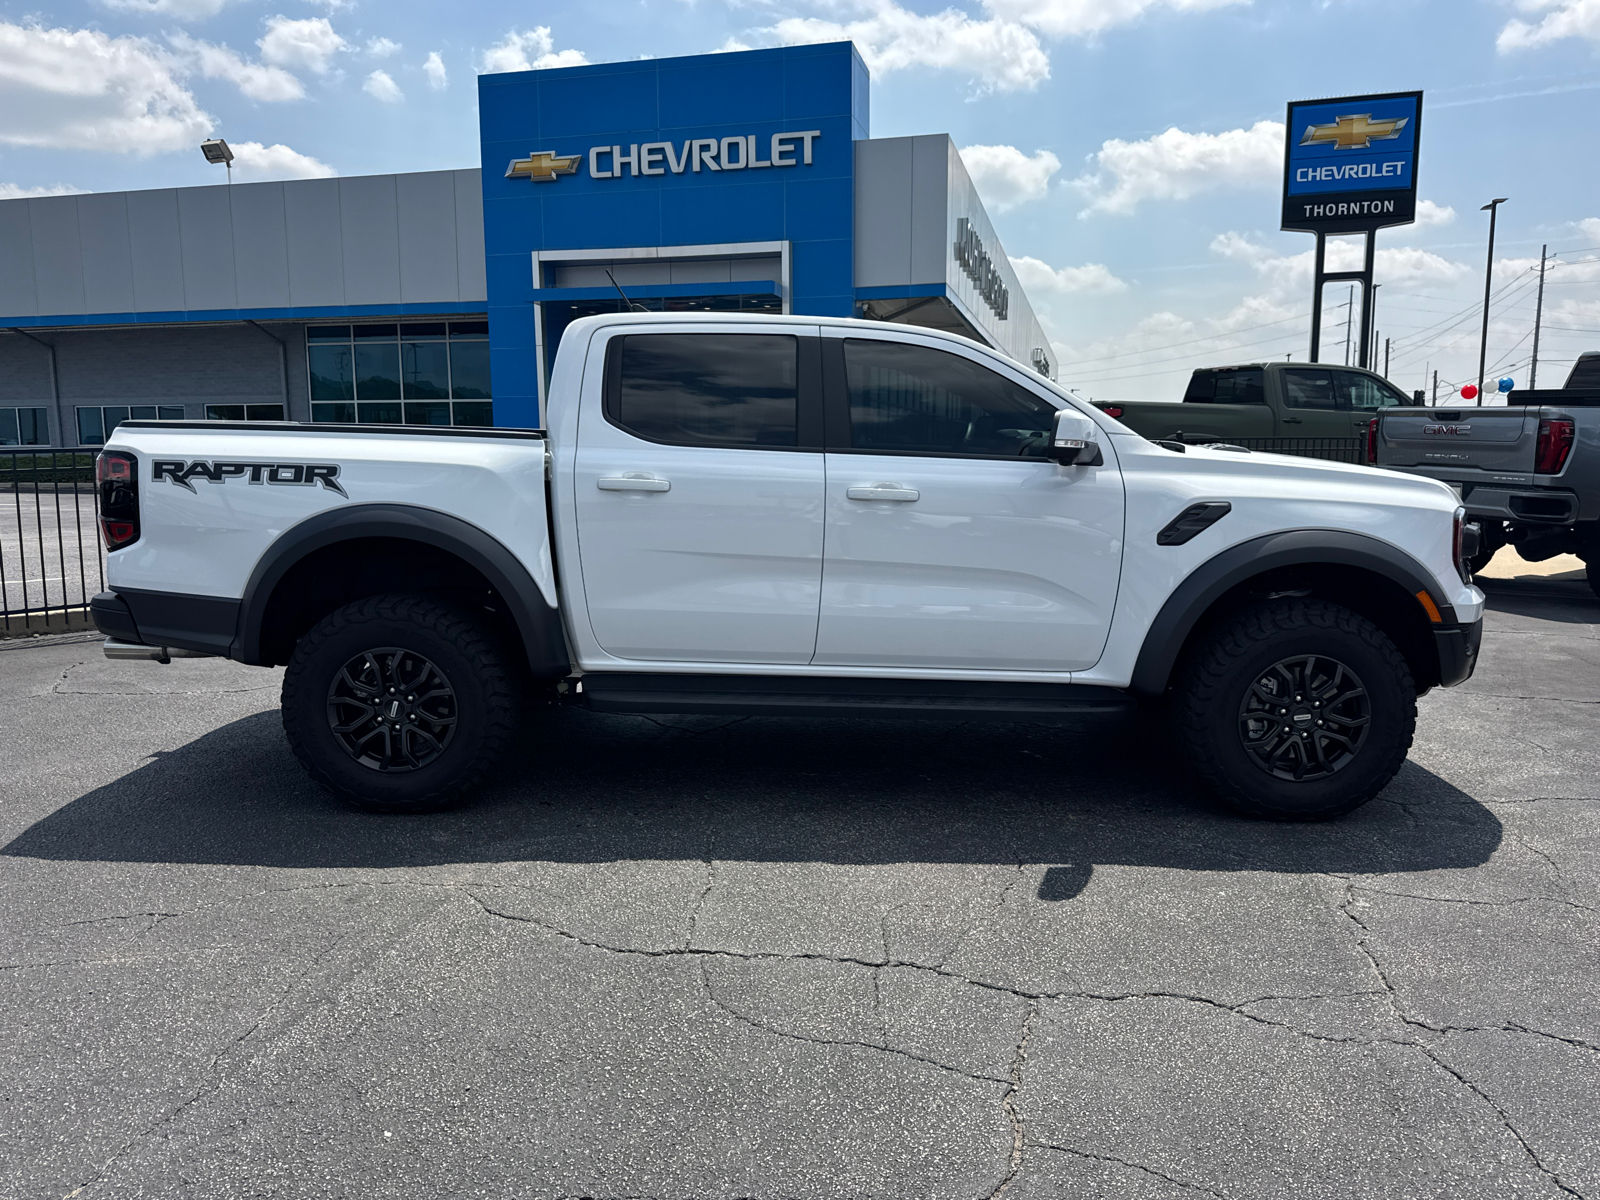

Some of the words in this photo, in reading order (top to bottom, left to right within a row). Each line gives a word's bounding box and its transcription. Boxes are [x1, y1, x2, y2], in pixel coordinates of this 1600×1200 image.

[589, 130, 821, 179] CHEVROLET
[1296, 161, 1406, 182] CHEVROLET
[1303, 200, 1395, 218] THORNTON
[1423, 424, 1471, 436] GMC
[151, 458, 350, 500] RAPTOR
